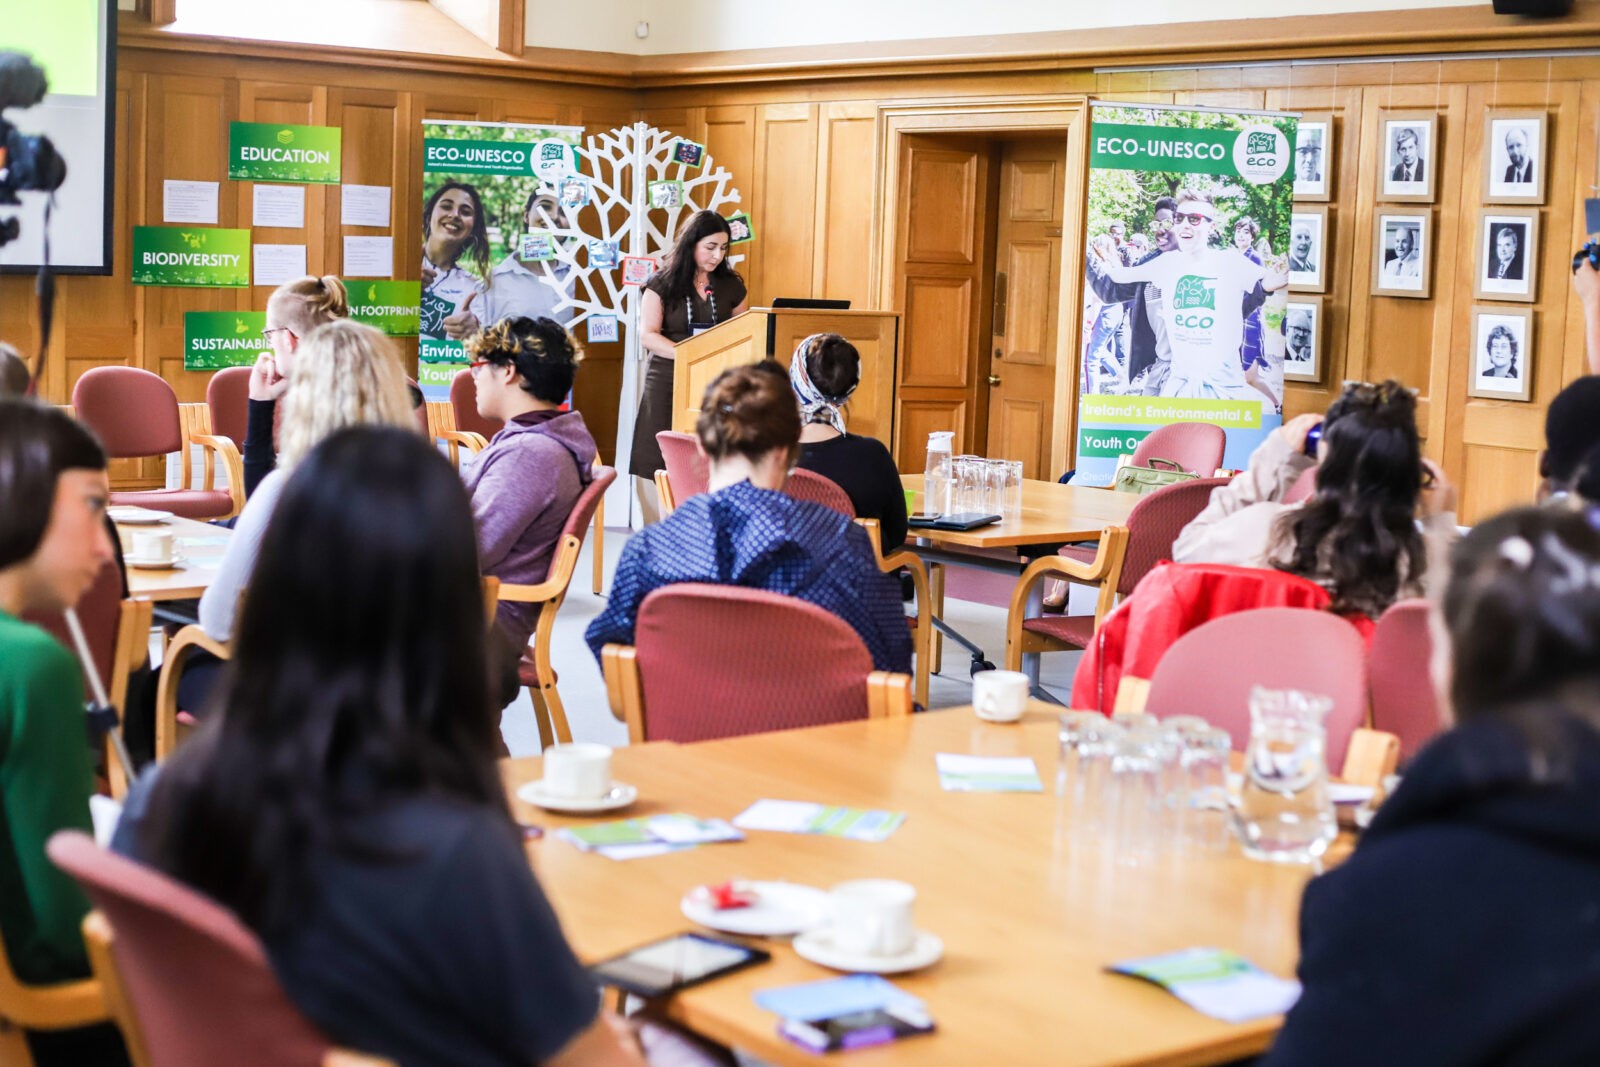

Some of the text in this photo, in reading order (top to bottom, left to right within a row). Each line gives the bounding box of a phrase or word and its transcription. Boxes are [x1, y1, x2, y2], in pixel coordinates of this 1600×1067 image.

[240, 146, 330, 164] EDUCATION
[428, 147, 525, 163] ECO-UNESCO
[1097, 137, 1225, 160] ECO-UNESCO
[1246, 157, 1276, 167] eco
[142, 252, 241, 267] BIODIVERSITY
[361, 305, 420, 316] FOOTPRINT
[1175, 313, 1214, 329] eco
[1085, 404, 1253, 422] Ireland's Environmental &
[1084, 435, 1122, 449] Youth
